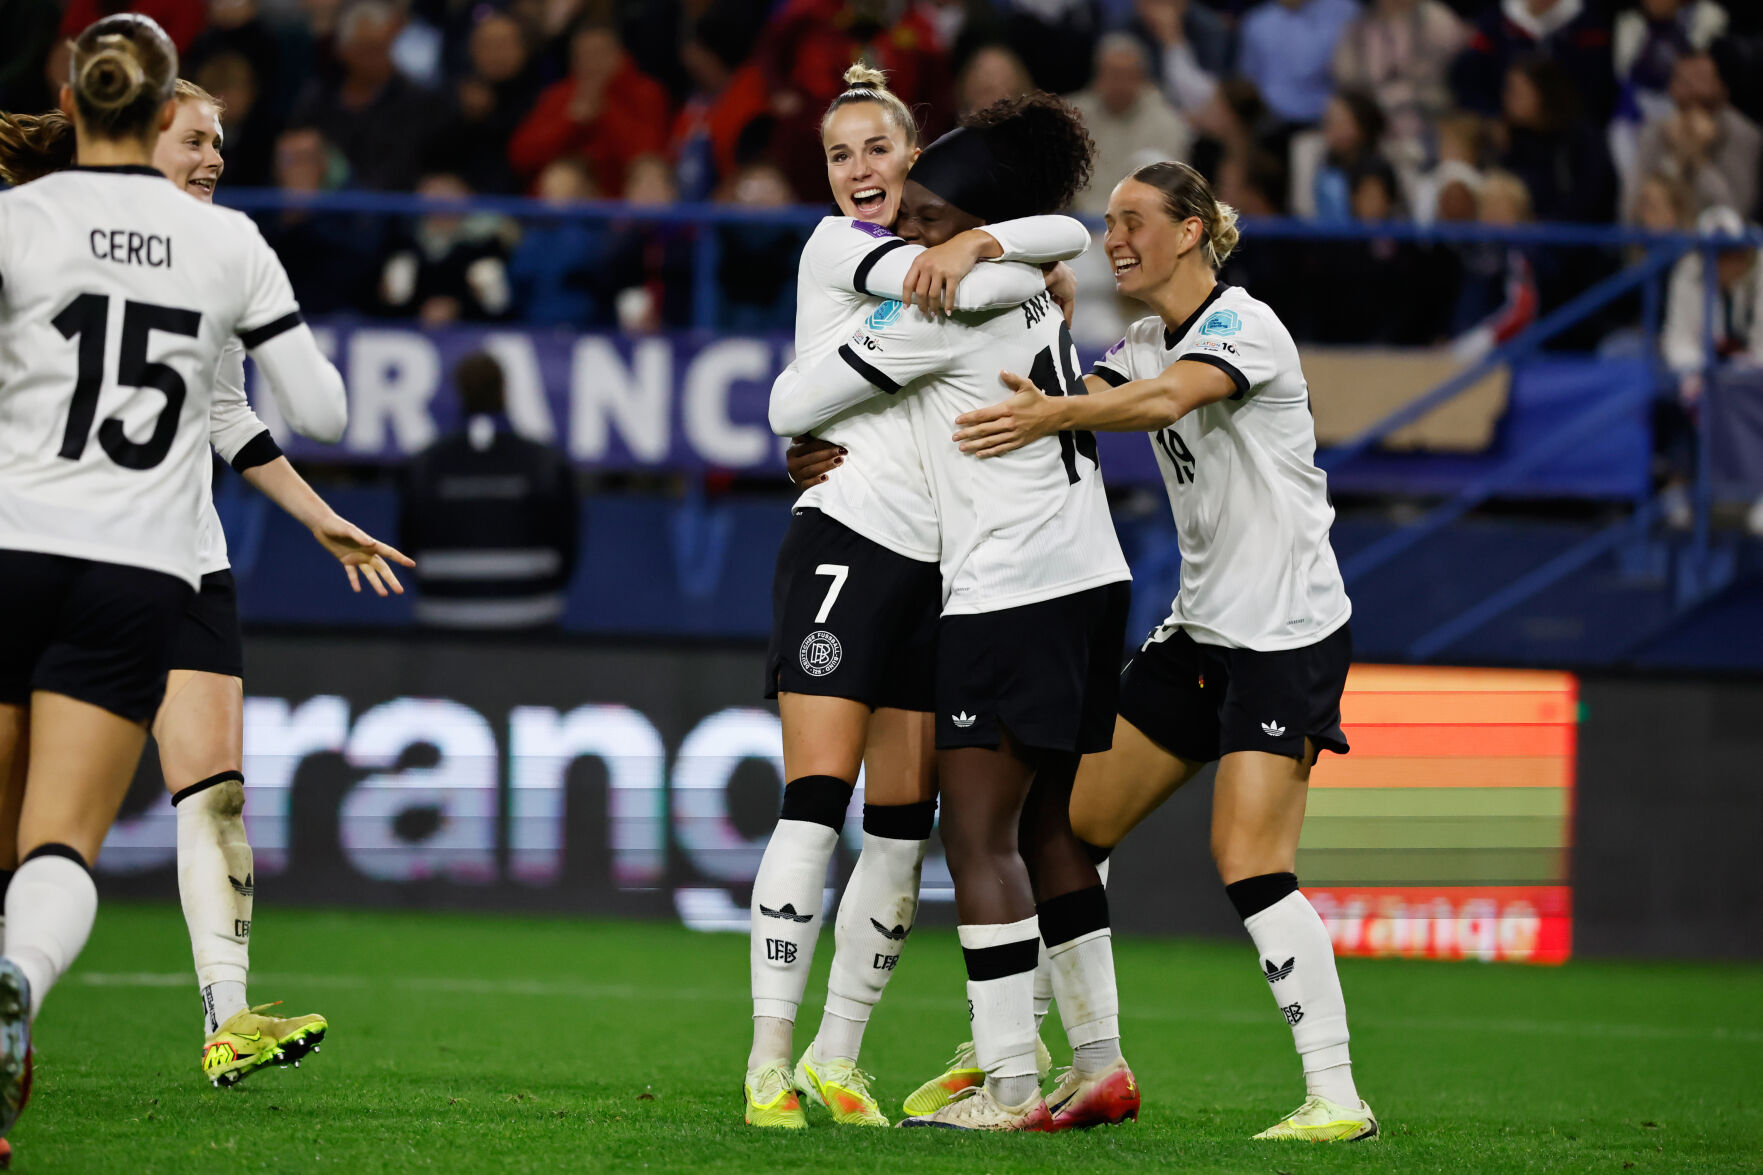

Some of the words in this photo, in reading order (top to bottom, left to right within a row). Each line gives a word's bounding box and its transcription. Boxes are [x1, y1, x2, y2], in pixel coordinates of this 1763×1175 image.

[90, 229, 172, 269] CERCI
[51, 292, 203, 471] 15
[252, 327, 797, 467] RANC
[1156, 428, 1196, 485] 19
[814, 563, 850, 624] 7
[84, 693, 955, 932] rang
